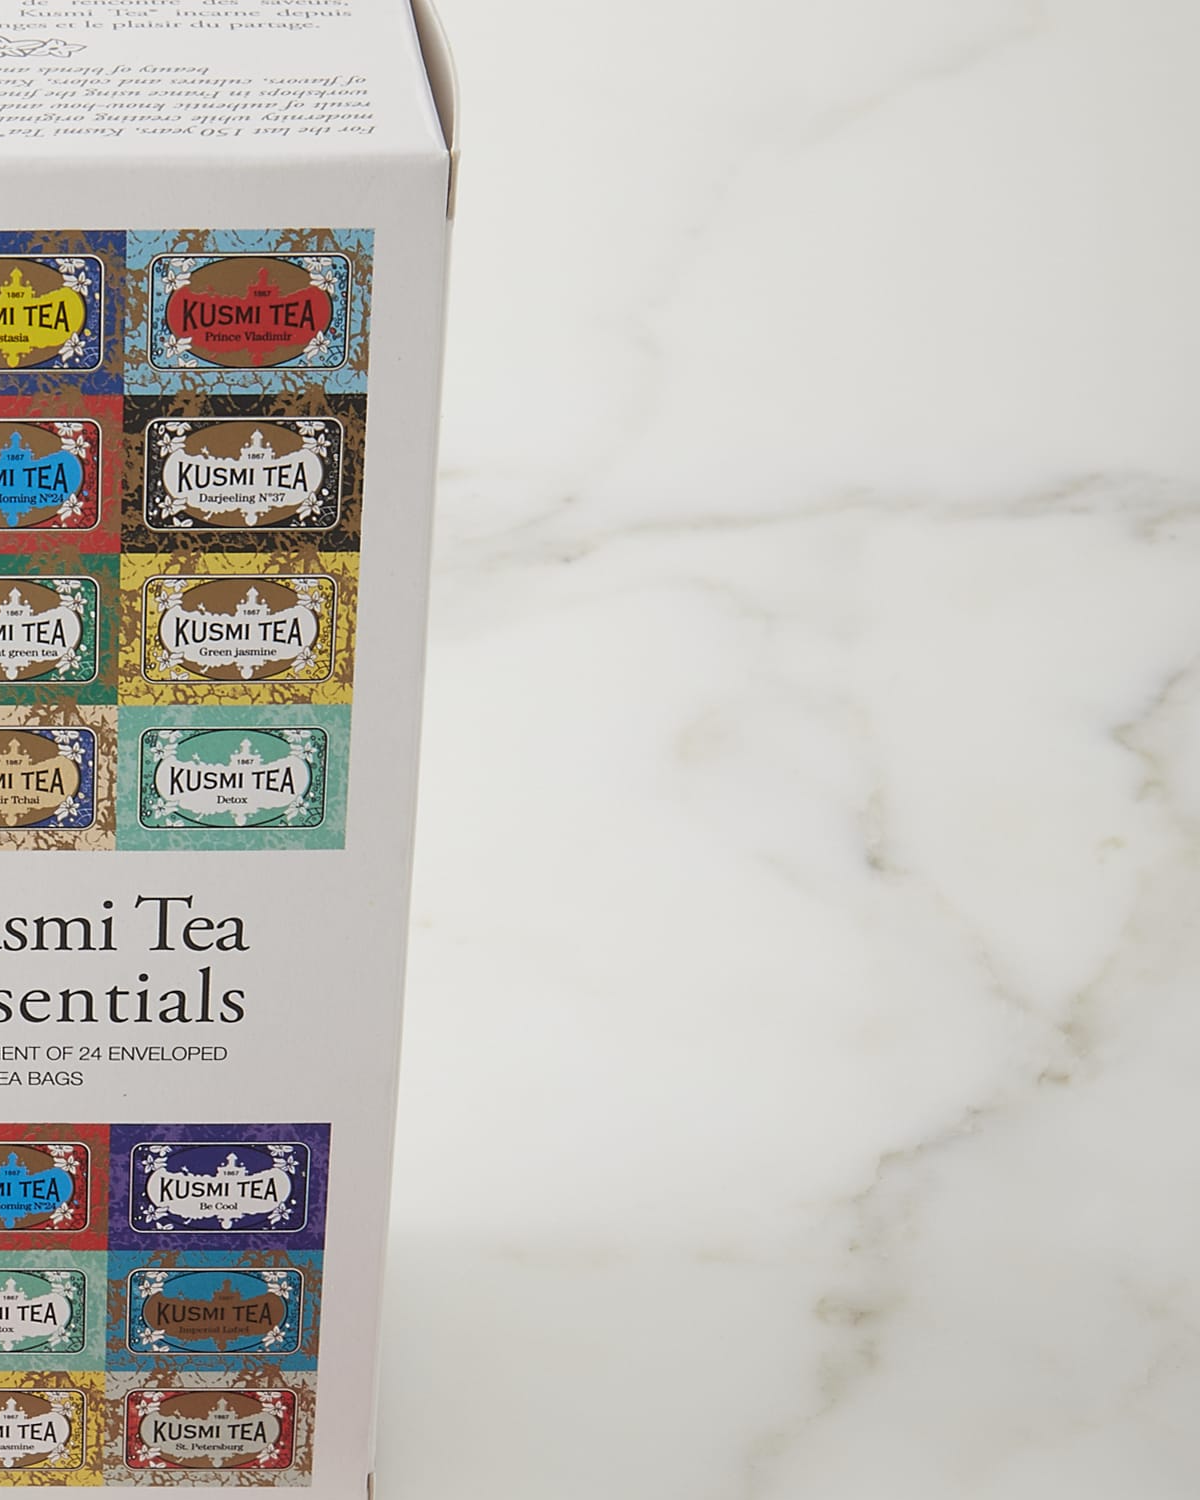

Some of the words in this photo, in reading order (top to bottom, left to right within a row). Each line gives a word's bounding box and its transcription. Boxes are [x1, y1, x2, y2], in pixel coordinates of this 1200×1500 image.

[113, 21, 180, 30] plaisir
[40, 67, 103, 75] blends
[106, 66, 131, 75] of
[140, 65, 209, 75] beauty
[95, 114, 181, 122] creating
[192, 115, 250, 124] while
[261, 112, 374, 122] modernity
[24, 301, 70, 332] TEA
[183, 299, 260, 332] KUSMI
[269, 300, 315, 333] TEA
[205, 332, 240, 342] Prince
[244, 332, 292, 342] Vladimir
[23, 463, 68, 493] TEA
[178, 462, 254, 492] KUSMI
[263, 462, 307, 492] TEA
[200, 494, 255, 504] Darjeeling
[22, 619, 66, 647] TEA
[176, 618, 249, 647] KUSMI
[258, 618, 302, 646] TEA
[8, 649, 42, 658] green
[46, 648, 58, 656] tea
[200, 647, 230, 656] Green
[234, 647, 277, 658] jasmine
[21, 768, 64, 795] TEA
[170, 767, 242, 795] KUSMI
[252, 767, 294, 794] TEA
[10, 796, 39, 804] Tchai
[216, 796, 247, 804] Detox
[134, 895, 250, 952] Tea
[46, 1046, 73, 1061] OF
[79, 1046, 102, 1061] 24
[109, 1046, 228, 1061] ENVELOPED
[28, 1071, 83, 1086] BAGS
[19, 1178, 60, 1202] TEA
[160, 1177, 228, 1202] KUSMI
[237, 1178, 277, 1202] TEA
[200, 1202, 214, 1210] Be
[215, 1202, 238, 1210] Cool
[17, 1302, 57, 1325] TEA
[158, 1302, 224, 1326] KUSMI
[232, 1302, 272, 1325] TEA
[18, 1422, 56, 1443] TEA
[154, 1420, 220, 1443] KUSMI
[228, 1422, 266, 1443] TEA
[190, 1444, 243, 1452] Petersburg
